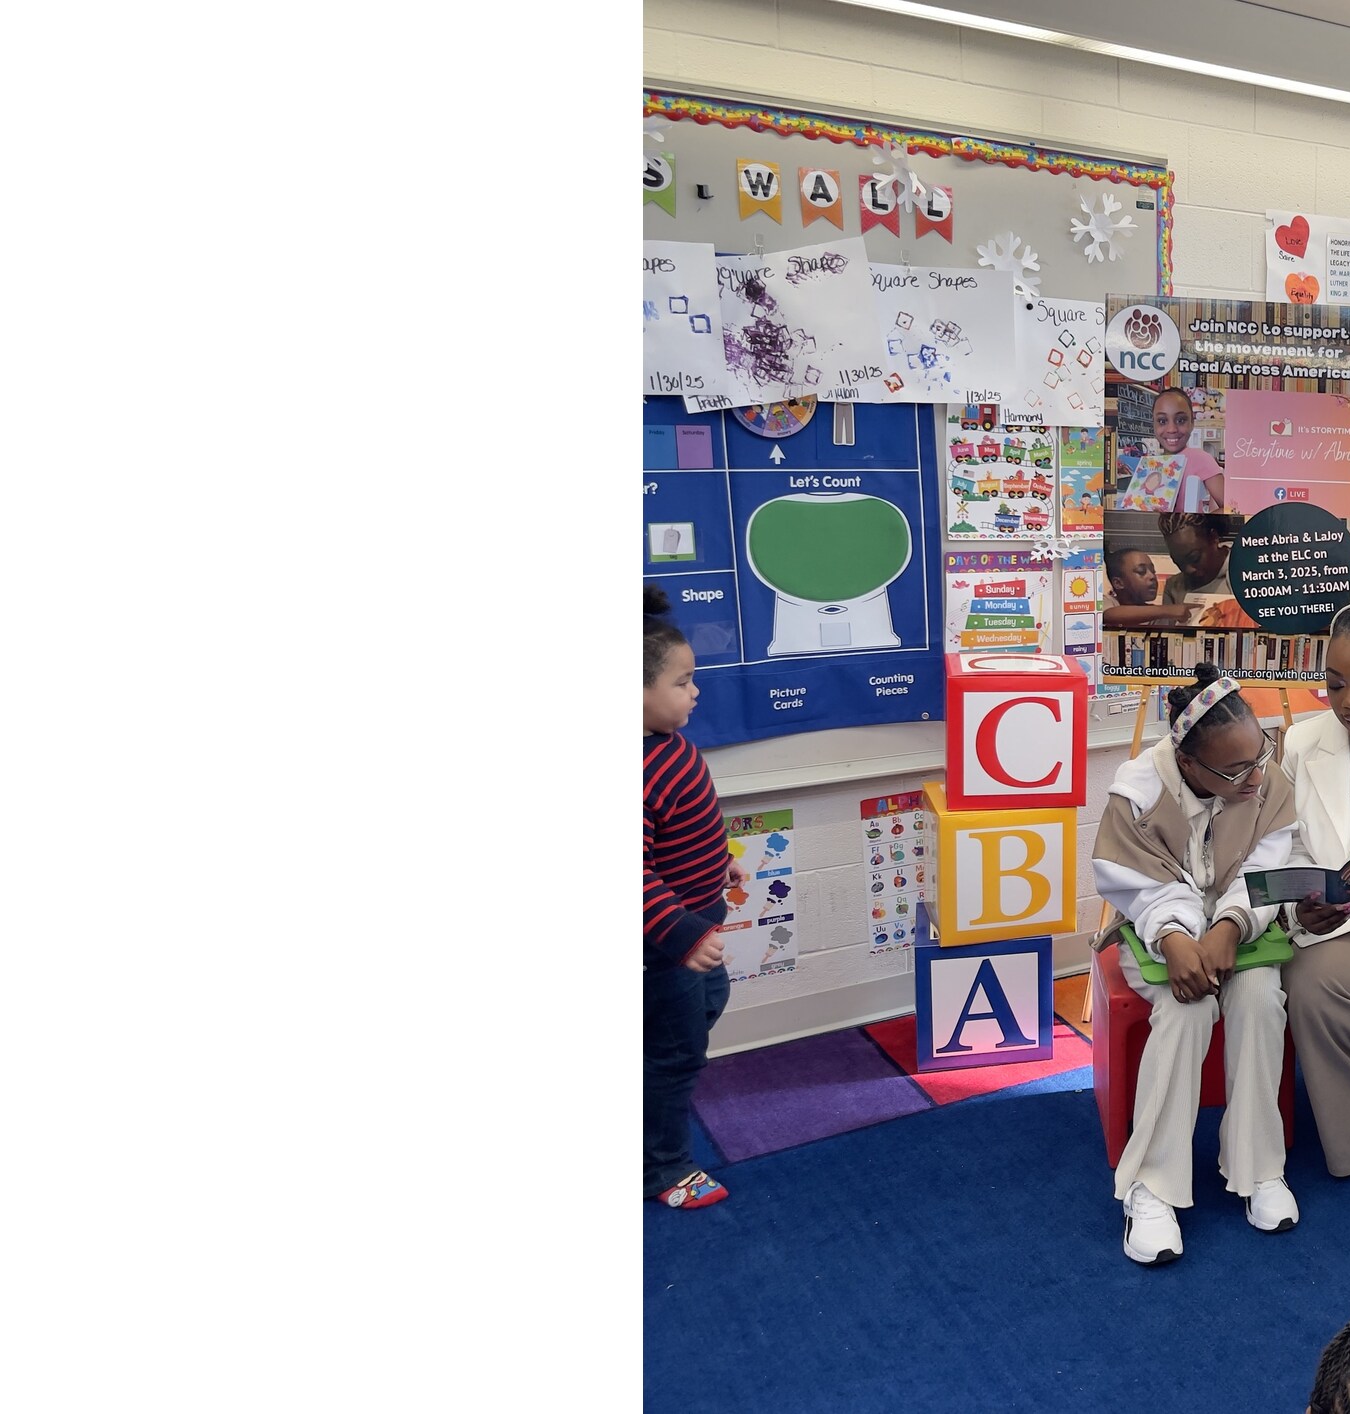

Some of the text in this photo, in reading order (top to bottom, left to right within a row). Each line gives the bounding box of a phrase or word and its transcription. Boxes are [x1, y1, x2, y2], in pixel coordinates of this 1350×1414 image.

[1285, 237, 1304, 246] Love
[1330, 259, 1350, 268] LEGACY
[871, 271, 978, 292] quare Shapes
[1290, 287, 1314, 301] Equality
[1037, 300, 1087, 325] Square
[1189, 319, 1225, 333] Join
[1227, 321, 1259, 335] NCC
[1262, 322, 1283, 336] to
[1284, 325, 1350, 340] support
[1195, 340, 1344, 359] the movement for
[1119, 350, 1166, 371] ncc
[1179, 359, 1219, 373] Read
[1222, 362, 1281, 377] Across
[650, 371, 704, 392] 1/30/25
[839, 366, 883, 386] 1/30/25
[687, 394, 734, 409] Truth
[966, 390, 1002, 404] 1/30/25
[1004, 408, 1044, 424] Harmony
[1297, 426, 1310, 434] It's
[984, 446, 995, 454] May
[1233, 437, 1295, 467] Storytime
[1301, 441, 1323, 460] w/
[1076, 460, 1093, 468] spring
[789, 475, 861, 488] Let's Count
[1004, 482, 1030, 490] September
[1032, 482, 1052, 492] October
[643, 482, 658, 495] r?
[995, 516, 1020, 525] December
[1024, 514, 1049, 523] November
[1241, 530, 1344, 547] Meet Abria & LaJoy
[948, 554, 977, 566] DAYS
[980, 554, 995, 565] OF
[998, 554, 1018, 565] THE
[1258, 549, 1327, 563] at the ELC on
[1242, 565, 1349, 581] March 3, 2025, from
[681, 588, 724, 603] Shape
[985, 585, 1015, 596] Sunday
[1243, 585, 1292, 599] 10:00AM
[1302, 580, 1350, 595] 11:30AM
[984, 600, 1017, 611] Monday
[1069, 603, 1090, 611] sunny
[1258, 603, 1335, 618] SEE YOU THERE!
[983, 617, 1017, 627] Tuesday
[976, 632, 1023, 643] Wednesday
[1072, 645, 1088, 654] rainy
[1102, 665, 1143, 676] Contact
[1274, 671, 1298, 680] with
[868, 673, 914, 687] Counting
[769, 686, 807, 699] Picture
[875, 686, 909, 697] Pieces
[1103, 684, 1120, 692] foggy
[773, 698, 804, 710] Cards
[975, 696, 1063, 789] C
[869, 816, 902, 828] Aa Bb
[871, 842, 904, 855] Ff Gg
[767, 869, 781, 877] blue
[872, 872, 883, 881] Kk
[968, 829, 1053, 927] B
[874, 901, 885, 909] Pp
[766, 914, 786, 925] purple
[722, 923, 745, 932] orange
[875, 921, 905, 934] Uu Vv
[936, 958, 1037, 1054] A
